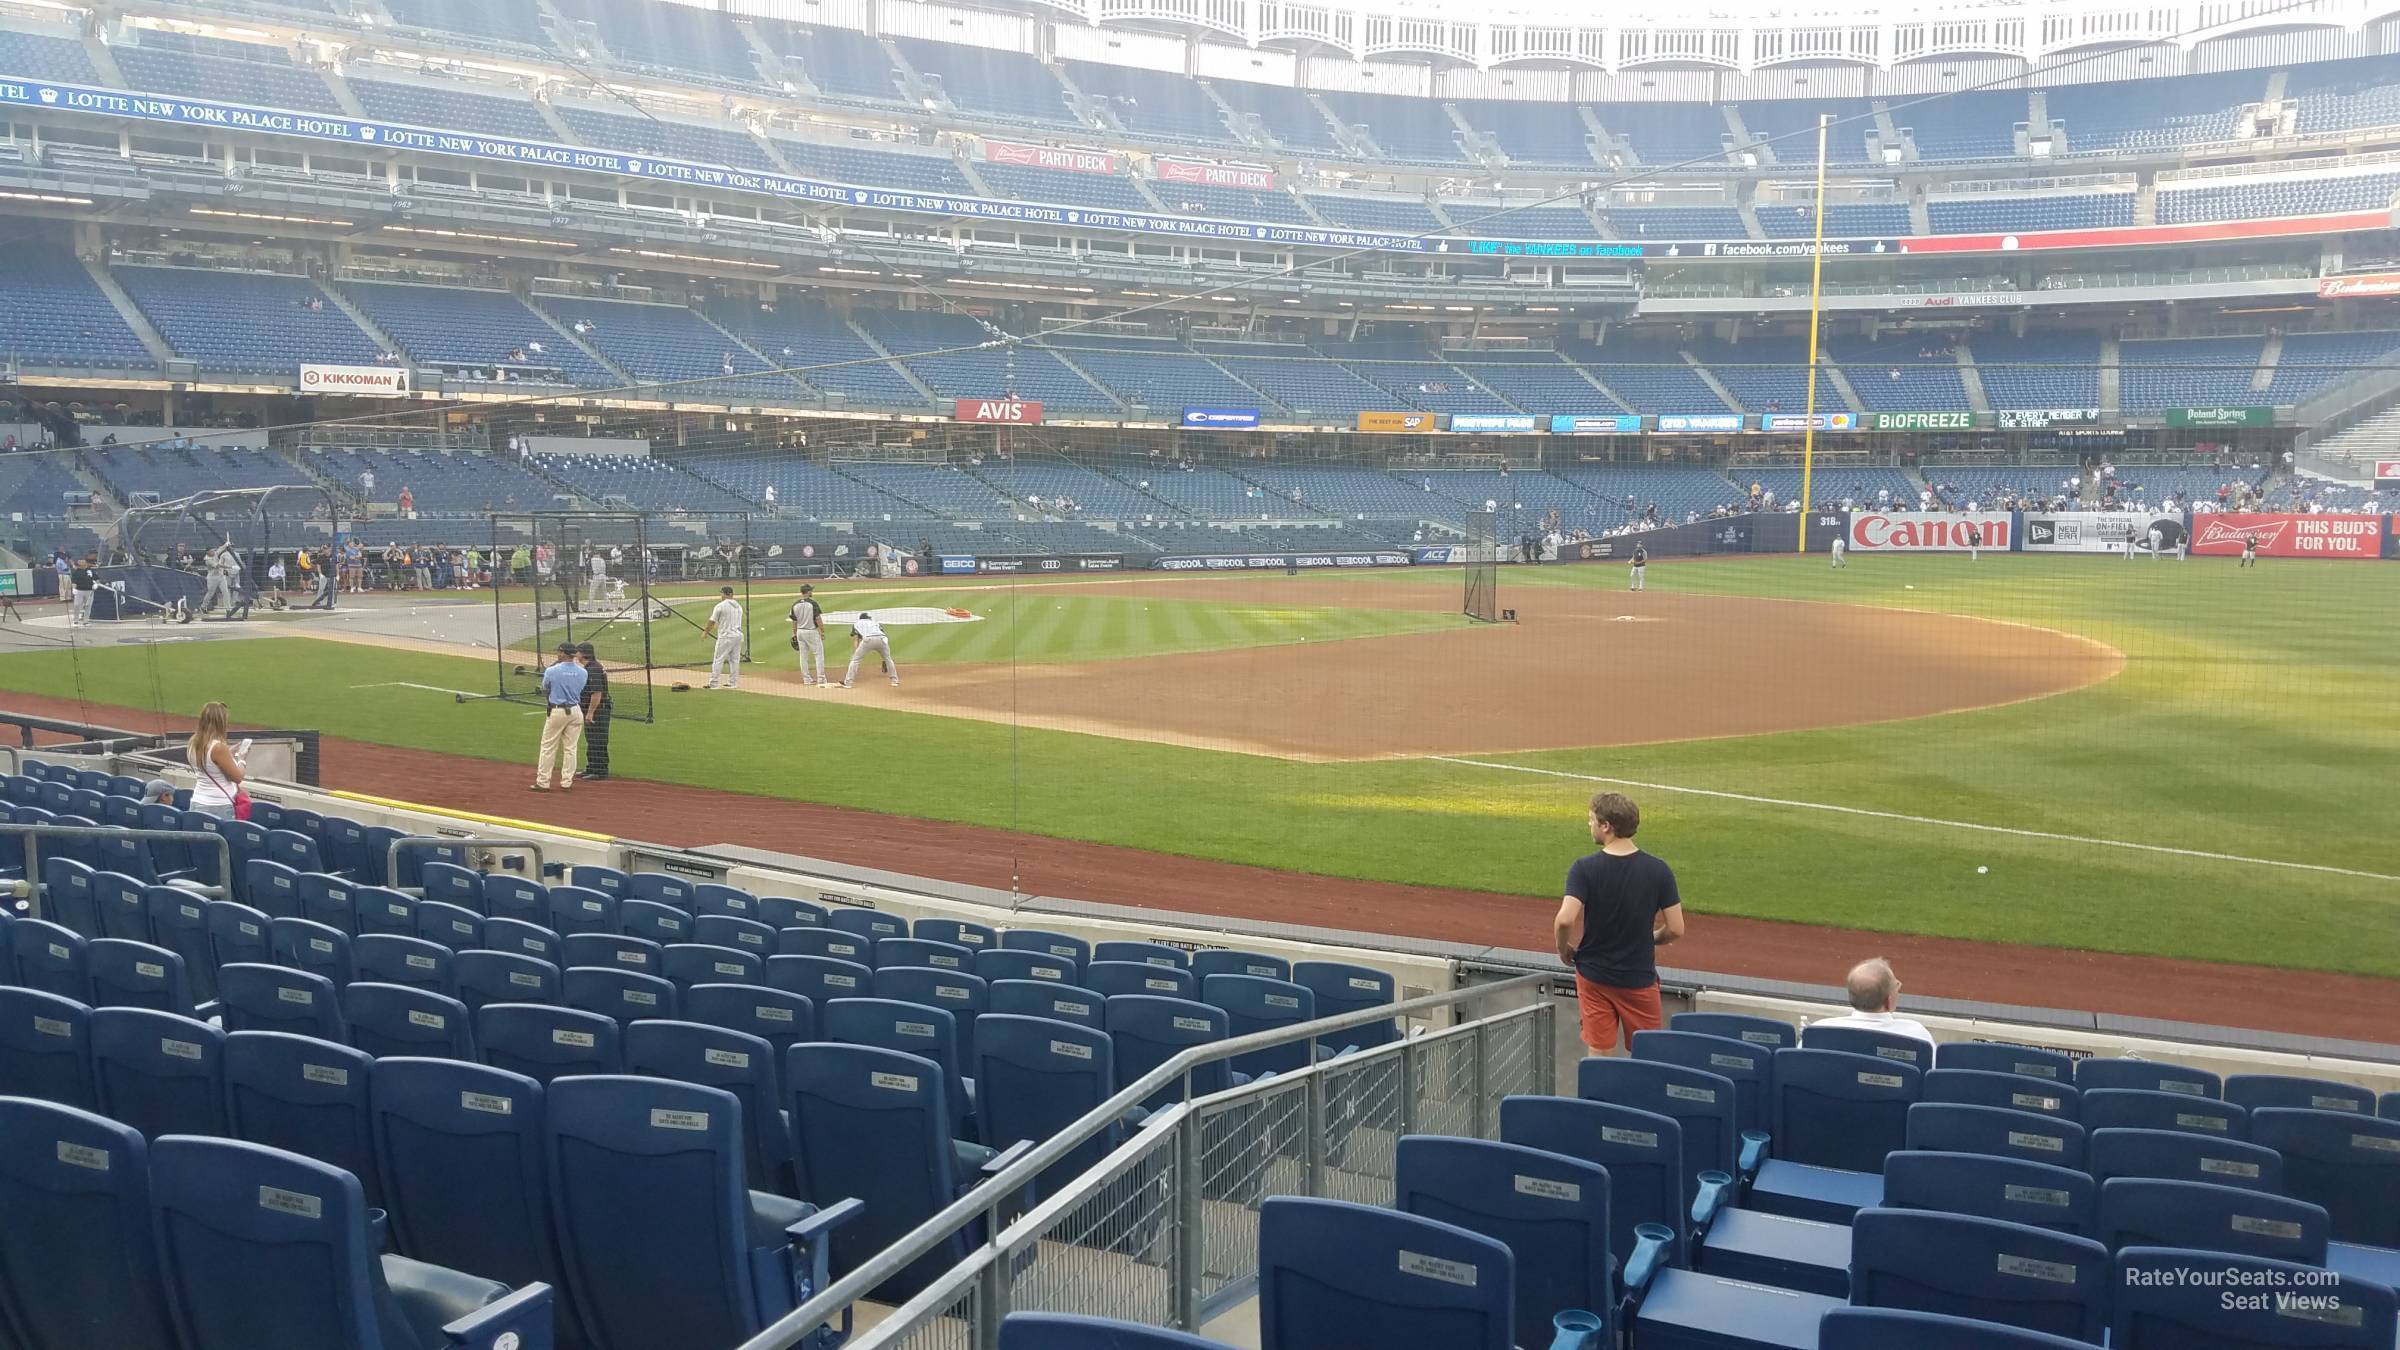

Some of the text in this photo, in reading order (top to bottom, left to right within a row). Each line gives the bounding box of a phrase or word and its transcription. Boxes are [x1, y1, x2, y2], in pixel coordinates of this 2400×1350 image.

[67, 92, 352, 137] LOTTE NEW YORK PALACE HOTEL
[384, 130, 621, 169] LOTTE NEW YORK PALACE HOTEL
[1040, 150, 1073, 166] PARTY
[1077, 154, 1106, 170] DECK
[648, 163, 848, 201] LOTTE NEW YORK PALACE HOTEL
[1206, 168, 1238, 184] PARTY
[1240, 172, 1267, 187] DECK
[874, 193, 1062, 221] LOTTE NEW YORK PALACE HOTEL
[1084, 214, 1252, 237] LOTTE NEW YORK PALACE HOTEL
[1271, 228, 1303, 239] LOTTE
[1304, 231, 1326, 242] NEW
[1329, 232, 1354, 244] YORK
[1525, 243, 1576, 256] YANKEES
[1924, 294, 2023, 306] Audi YANKEES CLUB
[323, 373, 392, 386] KIKKOMAN
[976, 402, 1022, 420] AVIS
[2016, 411, 2044, 420] EVERY
[2049, 410, 2082, 420] MEMBER
[2087, 409, 2099, 419] OF
[2187, 408, 2246, 421] Poland Spring
[1404, 416, 1421, 427] SAP
[2000, 419, 2048, 427] THE STAFF
[1853, 515, 2008, 548] Canon
[2295, 520, 2377, 535] THIS BUD'S
[2295, 536, 2362, 551] FOR YOU.
[1180, 559, 1203, 568] COOL
[1225, 559, 1245, 567] COOL
[1265, 558, 1287, 566] COOL
[1312, 557, 1333, 565] COOL
[1353, 556, 1373, 564] COOL
[1392, 555, 1410, 564] COOL
